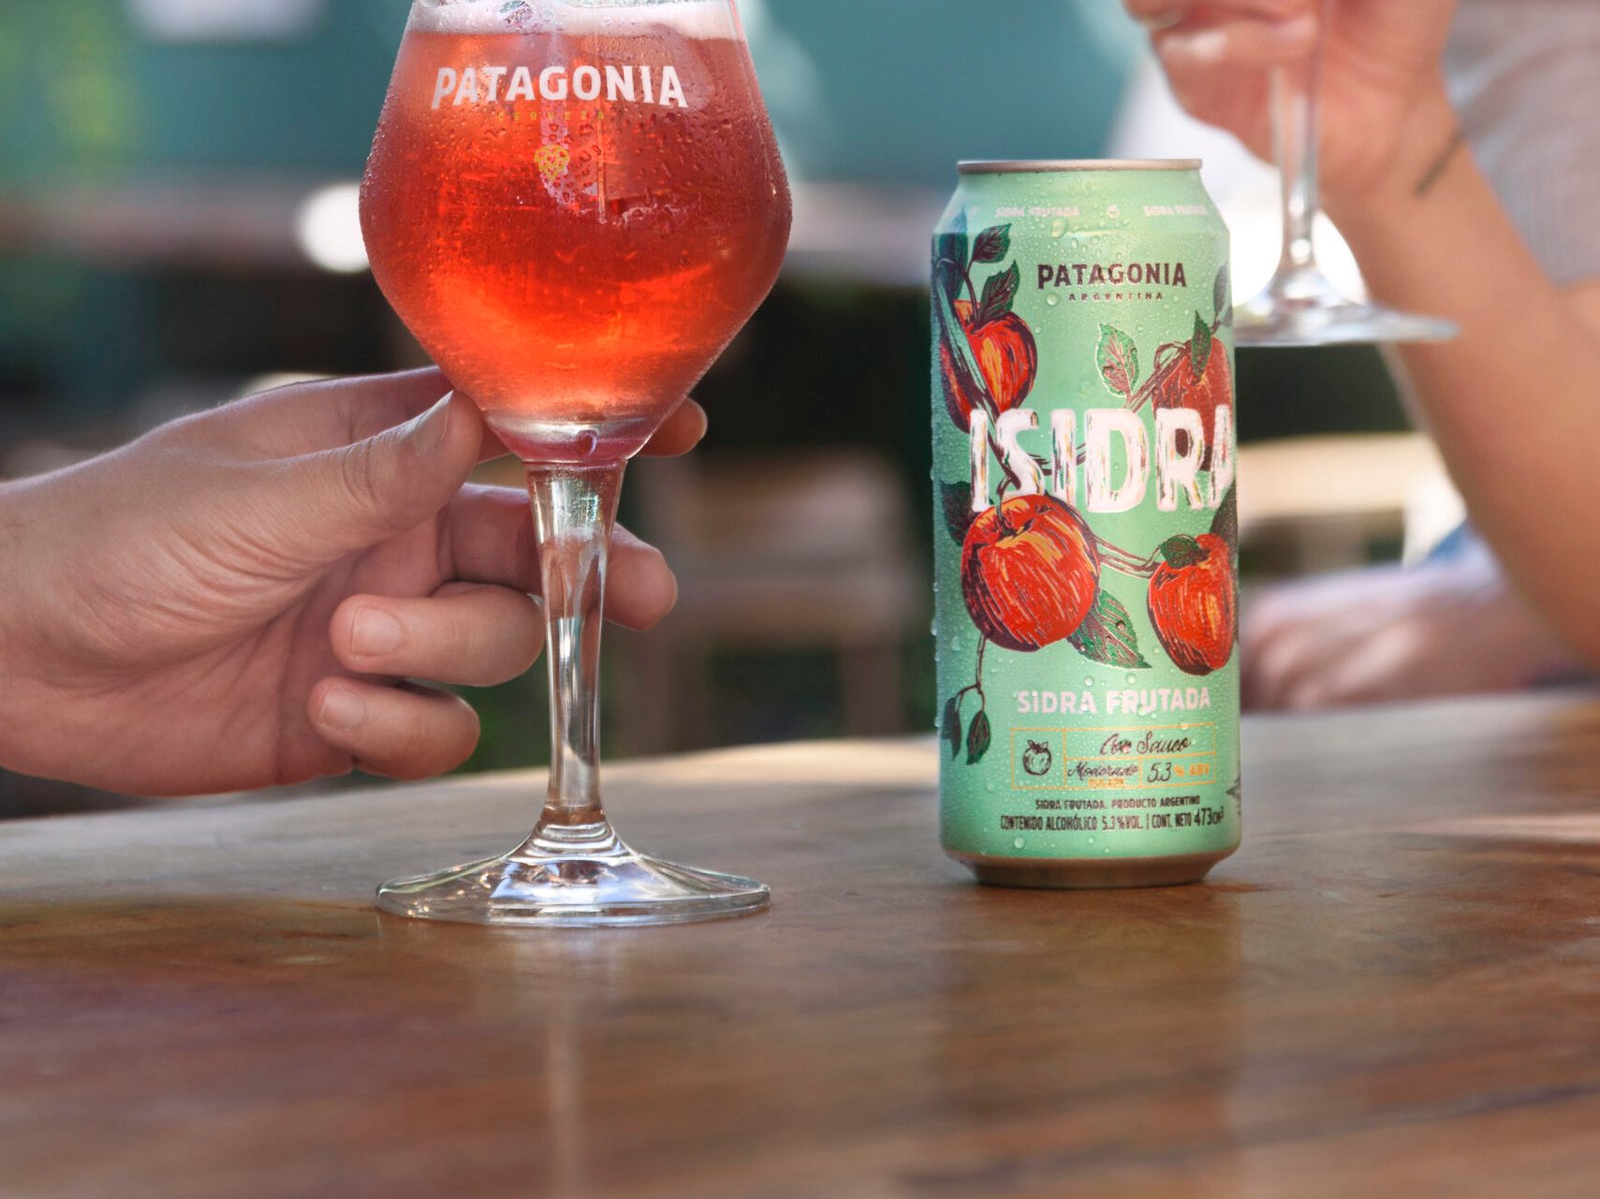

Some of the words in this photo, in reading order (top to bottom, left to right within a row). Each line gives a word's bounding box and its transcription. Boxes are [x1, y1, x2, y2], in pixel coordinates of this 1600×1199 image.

[431, 66, 688, 109] PATAGONIA
[1037, 262, 1187, 290] PATAGONIA
[1069, 292, 1162, 301] ARGENTINA
[970, 404, 1236, 513] ISIDRA
[1106, 687, 1211, 715] FRUTADA
[1035, 799, 1061, 810] SIDRA
[1111, 798, 1157, 809] PRODUCTO
[1160, 795, 1201, 807] ARGENTINO
[1000, 815, 1043, 831] CONTENIDO
[1046, 813, 1098, 831] ALCOHÓLICO
[1174, 812, 1192, 828] NETO
